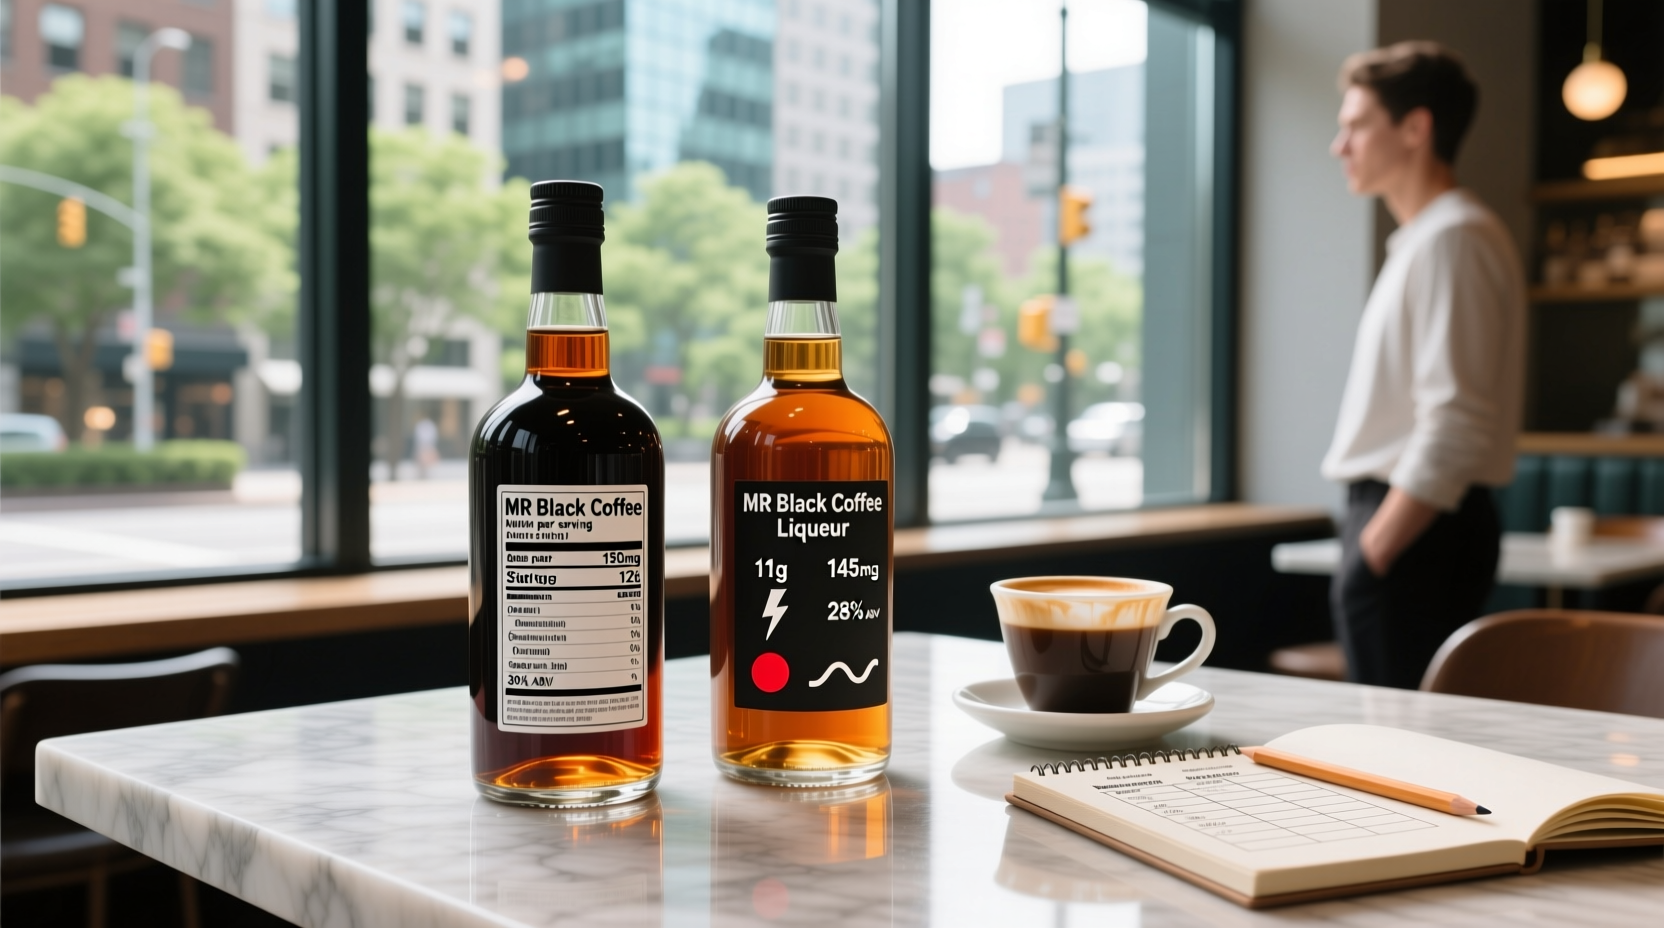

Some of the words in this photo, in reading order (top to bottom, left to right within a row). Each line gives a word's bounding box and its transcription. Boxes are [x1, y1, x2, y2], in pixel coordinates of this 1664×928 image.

[505, 497, 532, 516] MR
[537, 497, 586, 517] Black
[590, 497, 643, 517] Coffee
[743, 492, 772, 513] MR
[776, 492, 828, 513] Black
[831, 492, 883, 513] Coffee
[777, 517, 850, 544] Liqueur
[602, 551, 641, 567] 150mg
[754, 557, 788, 583] 11g
[827, 557, 879, 581] 145mg
[827, 599, 864, 621] 28%
